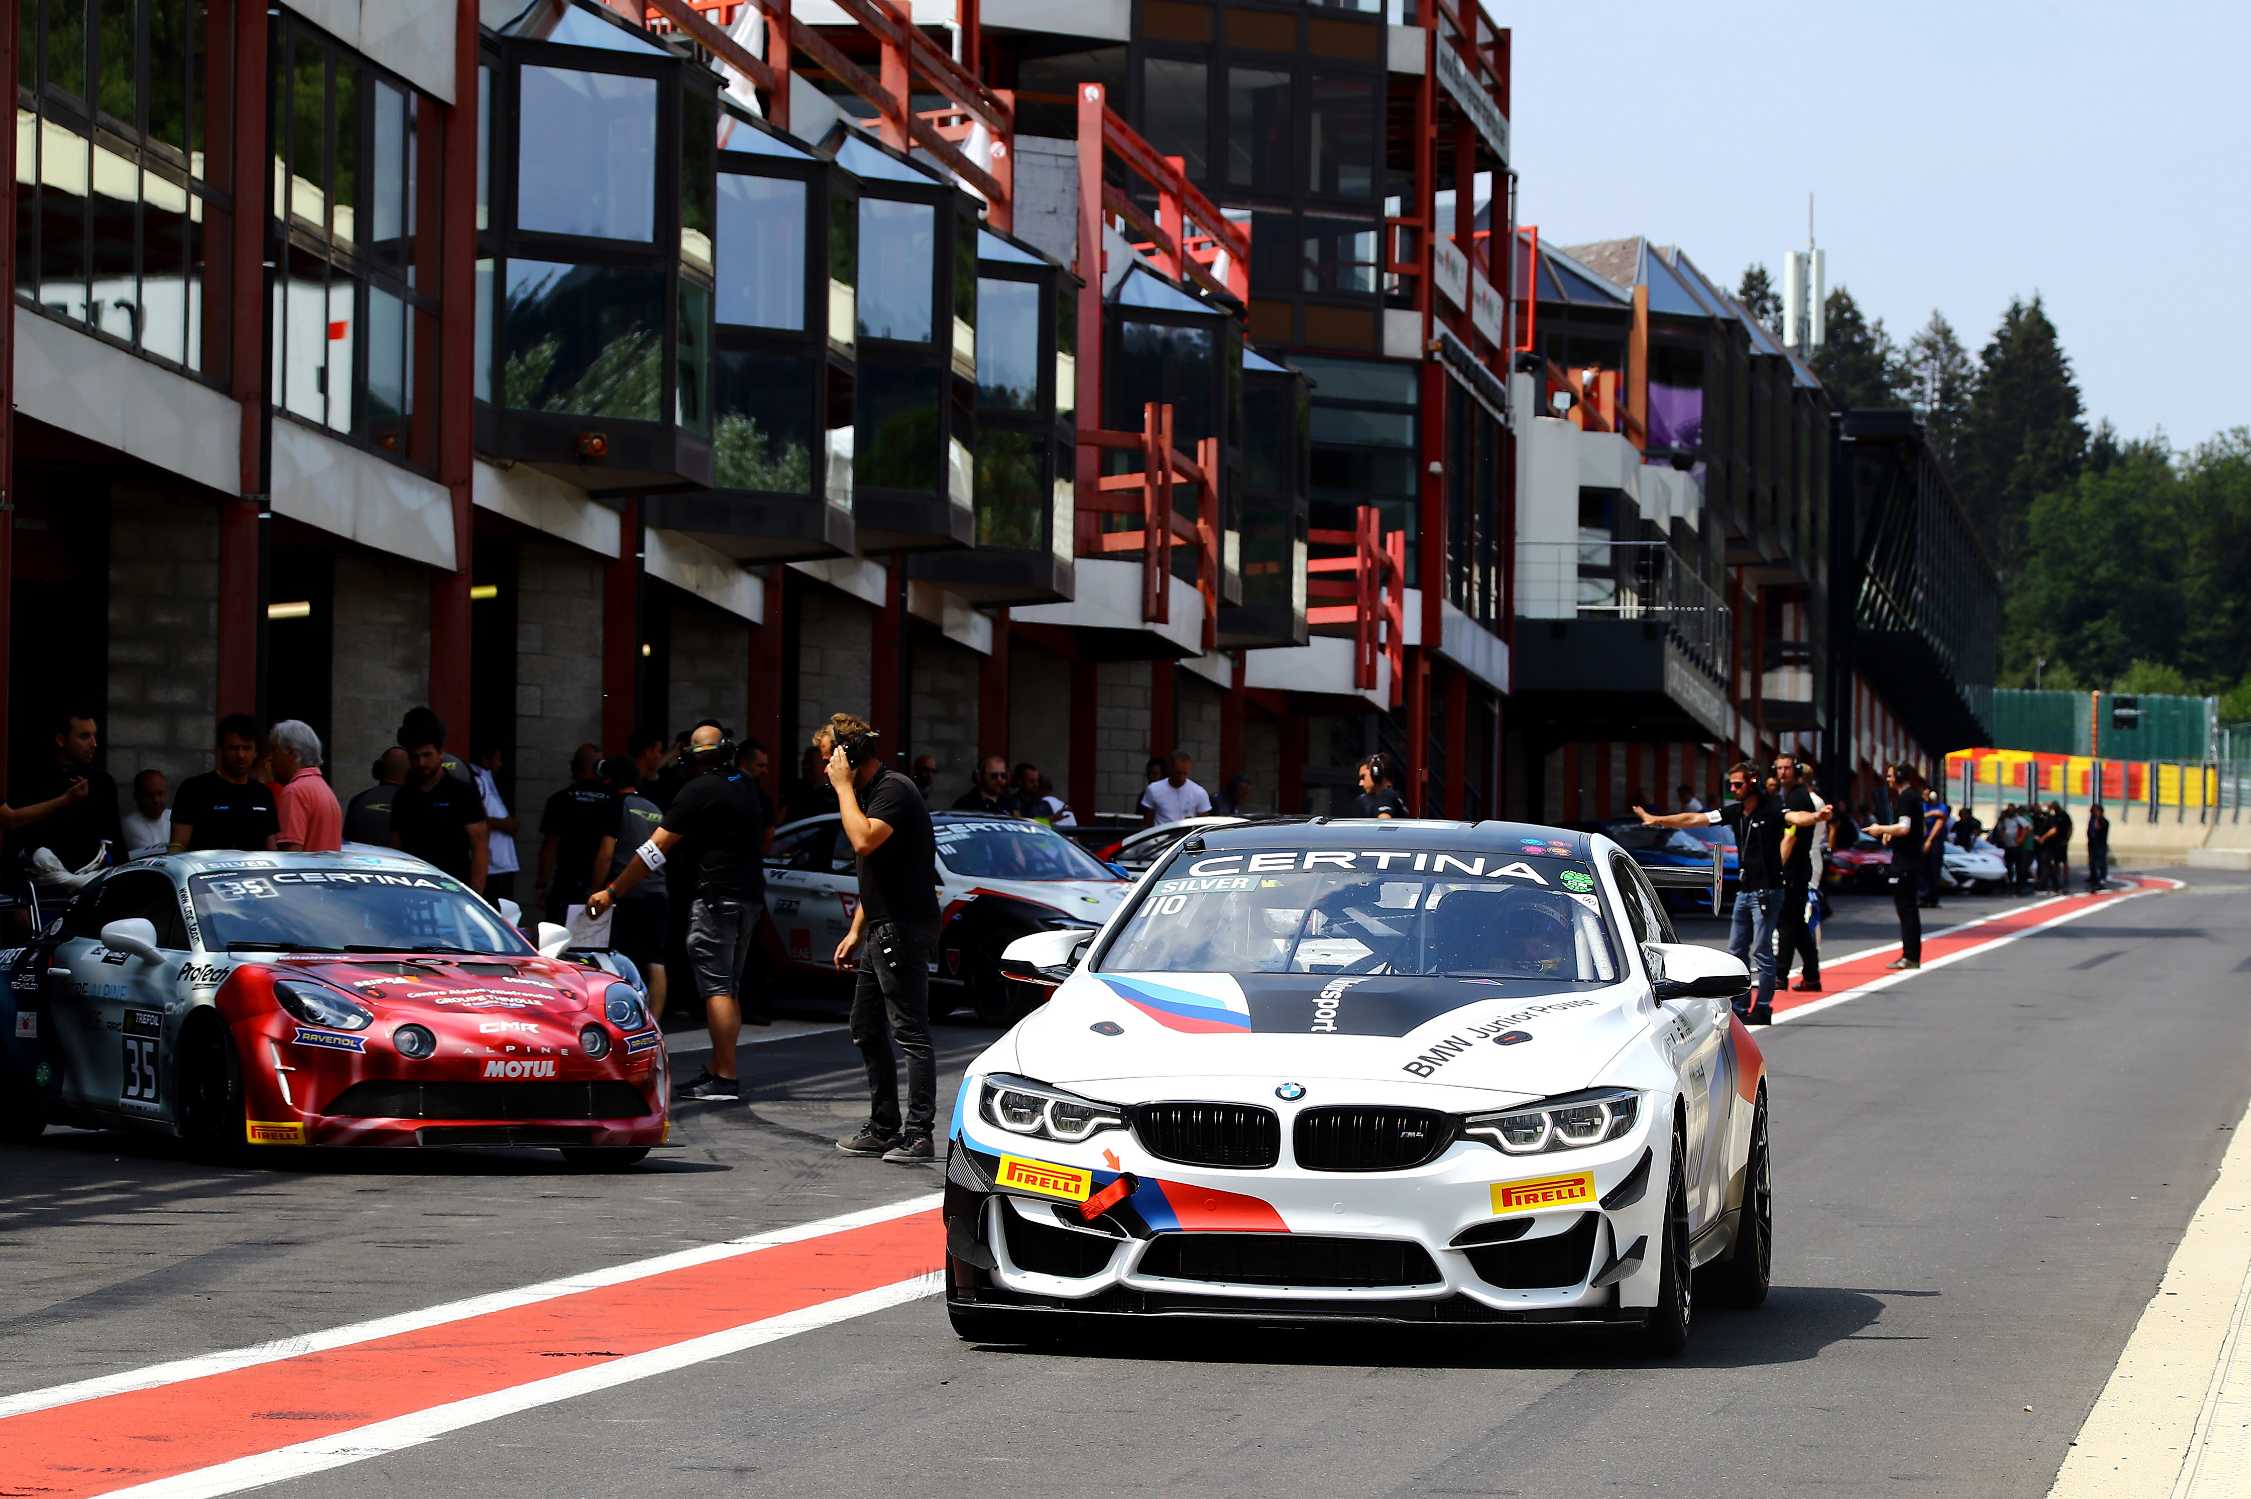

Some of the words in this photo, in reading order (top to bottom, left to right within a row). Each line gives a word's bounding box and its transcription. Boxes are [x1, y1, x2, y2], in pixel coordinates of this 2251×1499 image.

[207, 860, 272, 869] SILVER
[1188, 850, 1551, 886] CERTINA
[223, 879, 265, 895] 35
[273, 872, 443, 891] CERTINA
[1160, 876, 1251, 894] SILVER
[1139, 894, 1188, 919] 110
[176, 961, 232, 983] ProTech
[435, 995, 487, 1006] GROUPE
[135, 1012, 160, 1027] TREFOIL
[479, 1020, 540, 1034] CMR
[302, 1033, 358, 1048] RAVENOL
[1402, 1034, 1474, 1079] BMW
[1466, 1010, 1539, 1039] Junior
[1527, 998, 1600, 1016] Power
[462, 1044, 569, 1057] ALPINE
[126, 1039, 156, 1099] 35
[483, 1060, 556, 1078] MOTUL
[251, 1125, 299, 1140] PIRELLI
[1006, 1161, 1082, 1195] PIRELLI
[1501, 1177, 1586, 1208] PIRELLI
